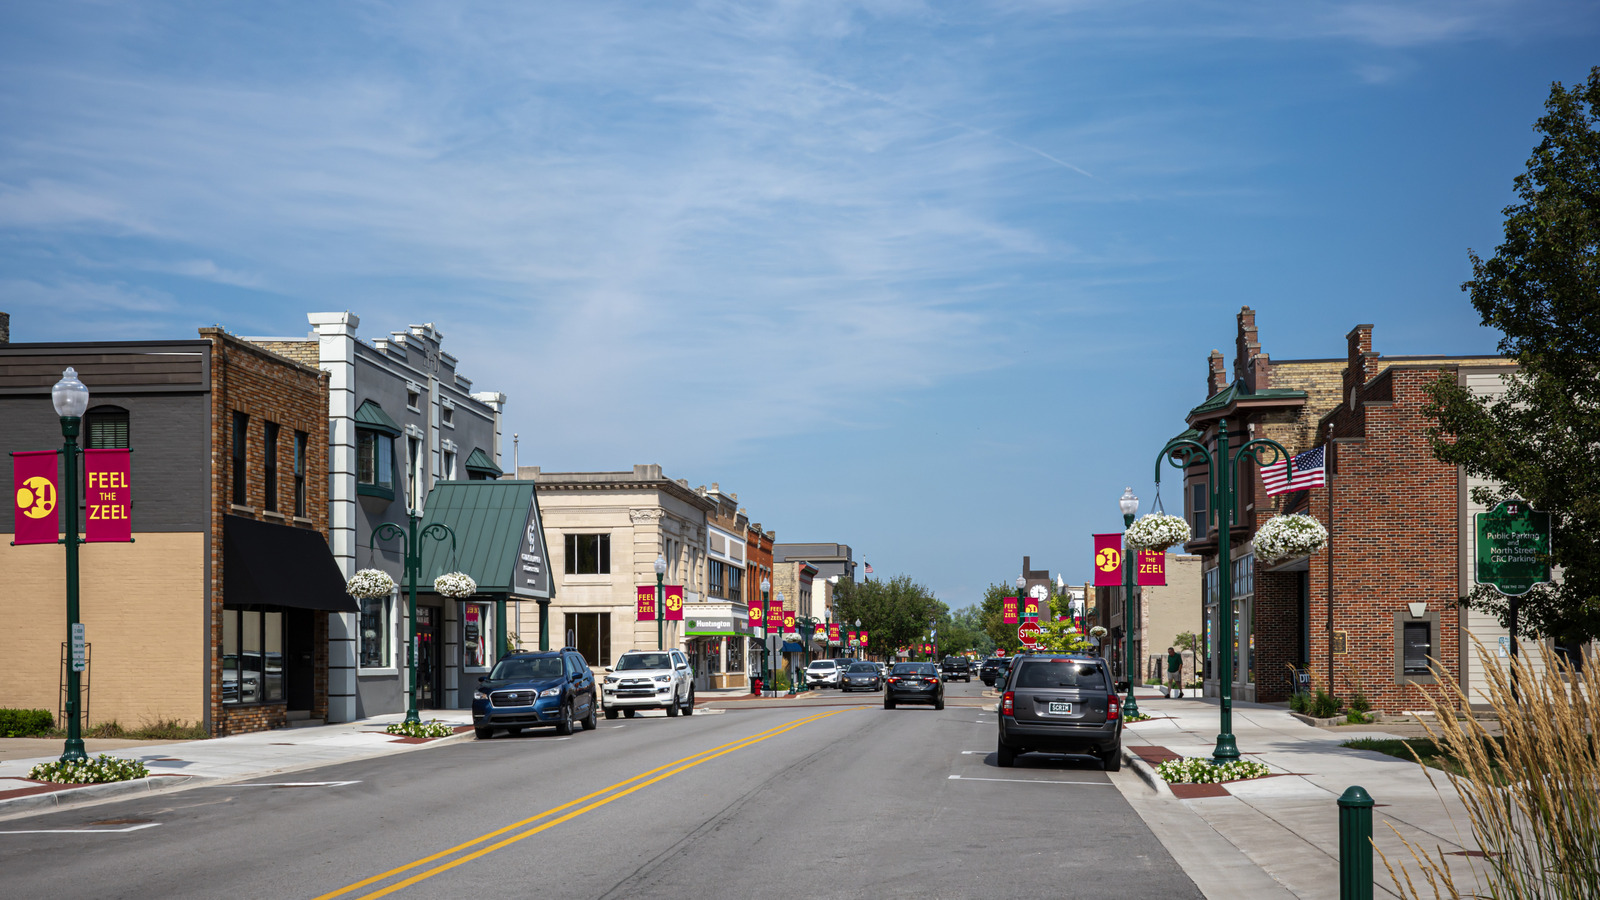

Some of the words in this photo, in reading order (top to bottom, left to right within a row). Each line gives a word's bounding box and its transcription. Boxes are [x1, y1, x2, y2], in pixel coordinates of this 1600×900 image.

[88, 471, 128, 488] FEEL
[99, 492, 117, 501] THE
[89, 504, 128, 519] ZEEL
[1487, 532, 1509, 540] Public
[1511, 532, 1540, 541] Parking
[1514, 546, 1536, 554] Street
[1490, 555, 1507, 563] CRC
[1508, 555, 1536, 564] Parking
[1139, 564, 1164, 573] ZEEL
[696, 619, 731, 630] Huntington
